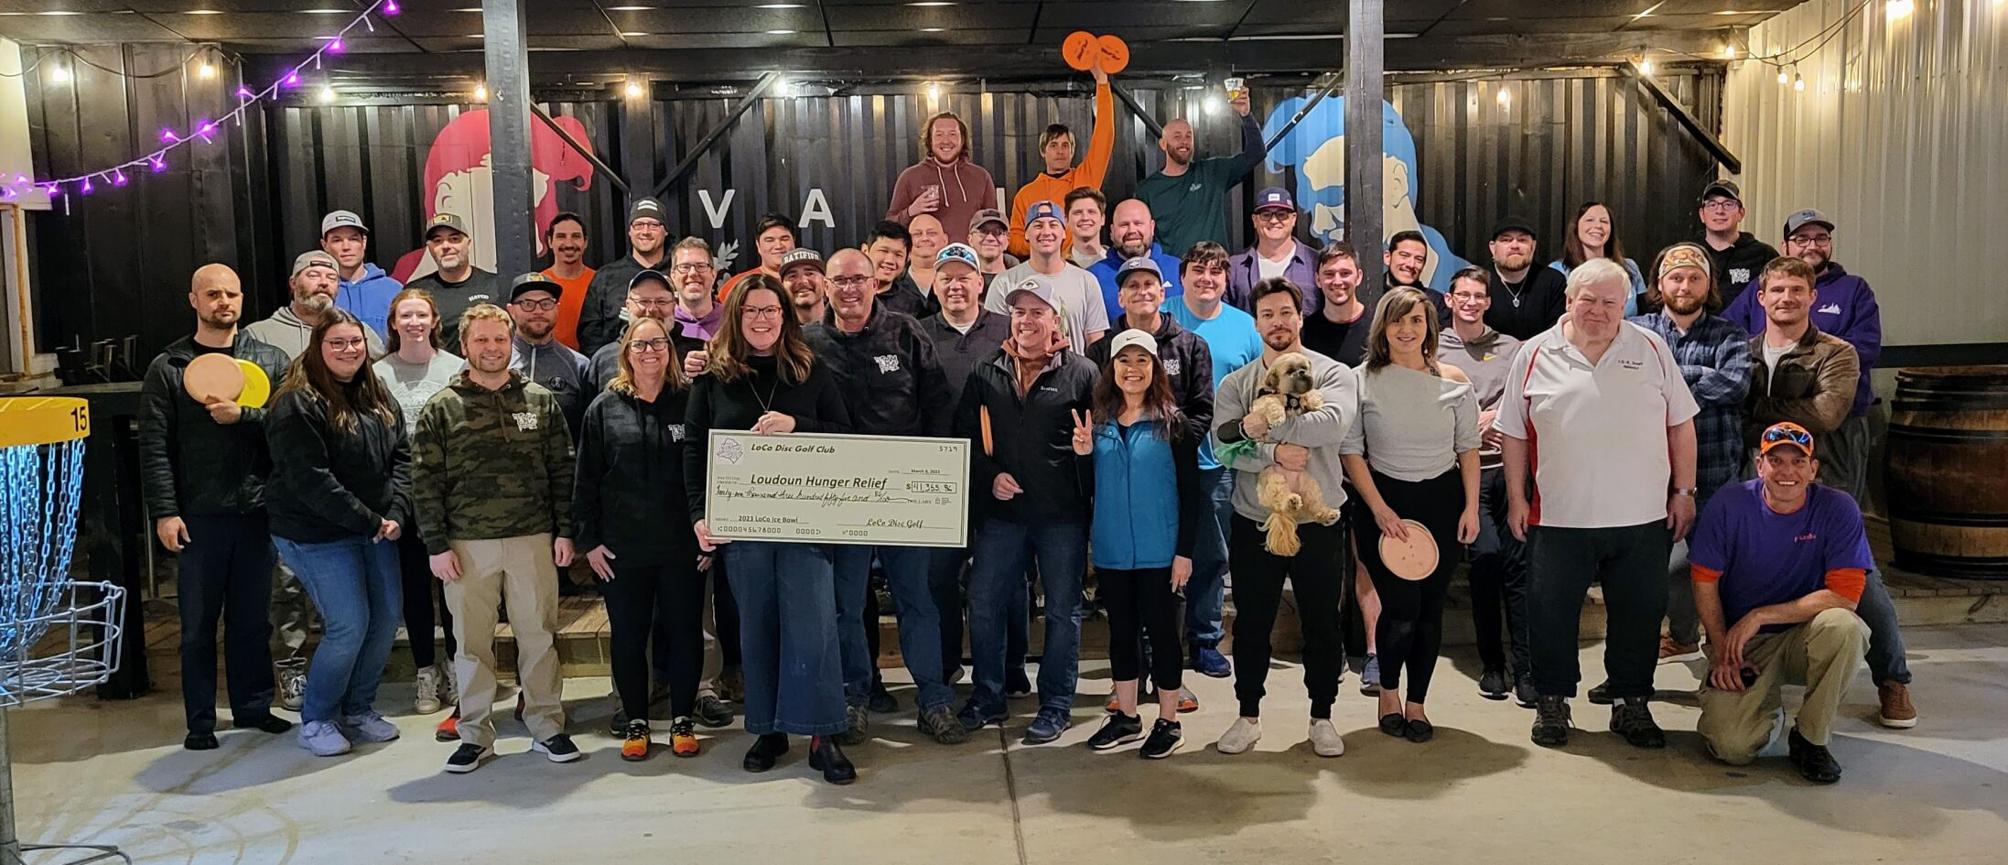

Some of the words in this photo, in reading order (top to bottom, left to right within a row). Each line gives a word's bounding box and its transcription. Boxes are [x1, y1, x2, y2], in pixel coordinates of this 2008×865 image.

[783, 251, 820, 264] RATIFIED
[70, 406, 88, 432] 15
[751, 443, 773, 452] LoCo
[775, 444, 792, 453] Disc
[795, 445, 814, 453] Golf
[816, 446, 836, 454] Club
[750, 474, 802, 486] Loudoun
[805, 476, 850, 489] Hunger
[852, 478, 888, 490] Relief
